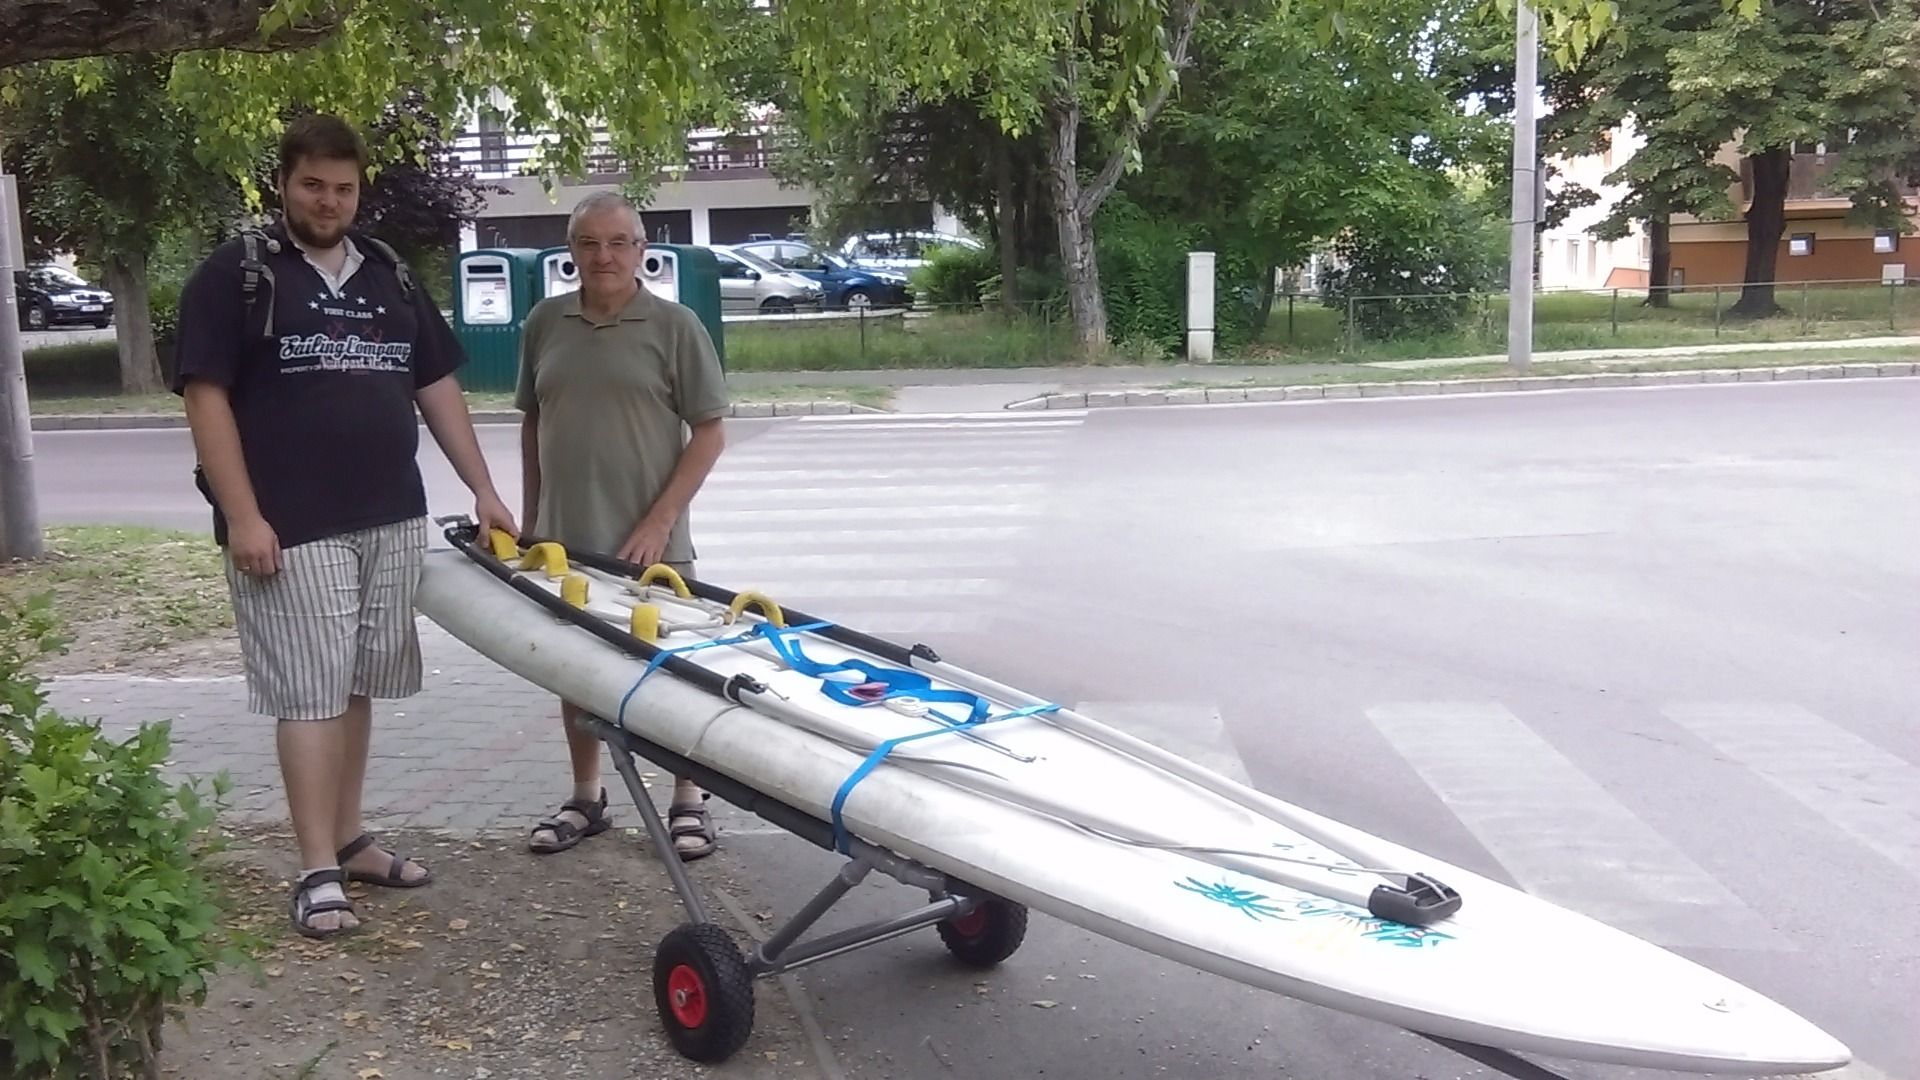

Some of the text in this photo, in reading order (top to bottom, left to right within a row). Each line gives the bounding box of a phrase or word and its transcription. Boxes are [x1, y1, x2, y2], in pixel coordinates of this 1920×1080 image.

[345, 310, 374, 319] CLASS
[279, 333, 412, 362] Sailing Company
